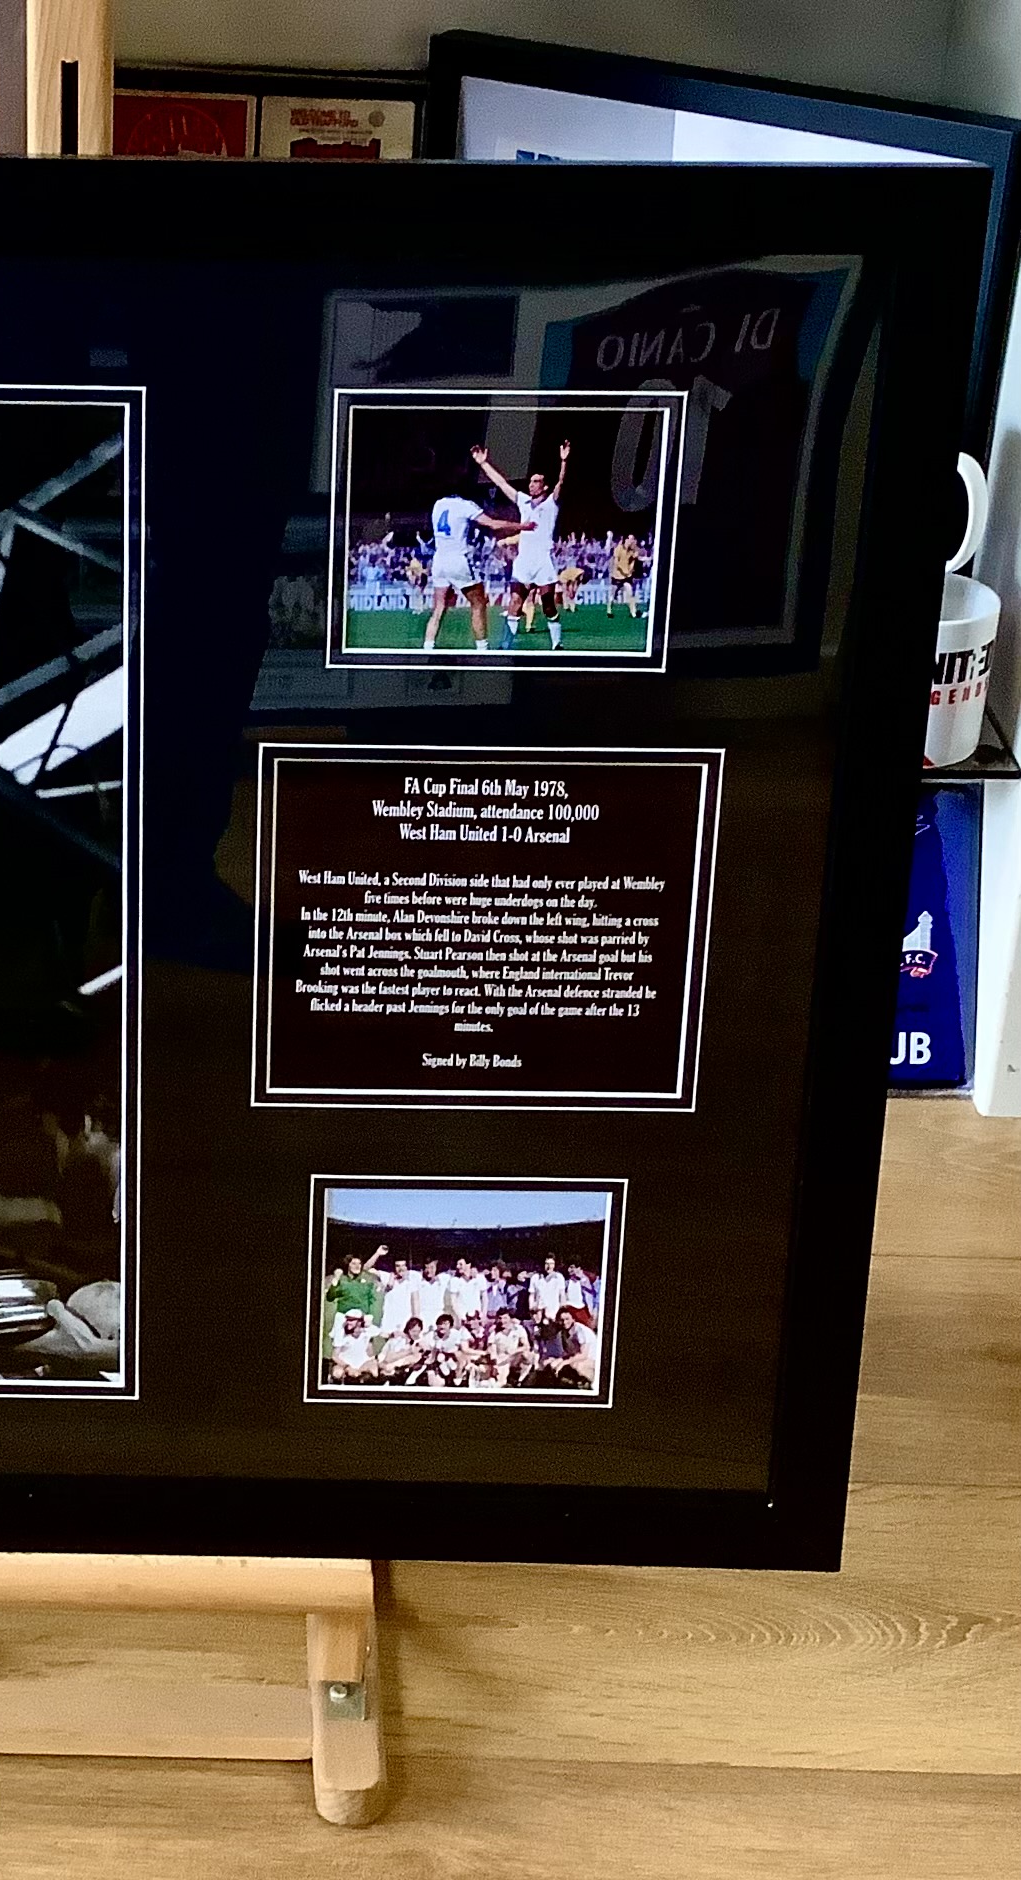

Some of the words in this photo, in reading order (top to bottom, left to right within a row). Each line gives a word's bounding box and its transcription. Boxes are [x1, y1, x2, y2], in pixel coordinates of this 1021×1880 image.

[436, 509, 452, 537] 4
[404, 776, 421, 795] FA
[423, 777, 447, 798] Cup
[449, 777, 479, 796] Final
[481, 778, 502, 796] 6th
[504, 778, 530, 799] May
[533, 780, 569, 800] 1978,
[371, 799, 425, 820] Wembley
[426, 800, 478, 820] Stadium,
[479, 802, 544, 820] attendance
[548, 803, 600, 823] 100,000
[399, 822, 427, 840] West
[429, 823, 457, 841] Ham
[459, 823, 498, 842] United
[501, 825, 523, 843] 1-0
[524, 826, 571, 844] Arsenal
[298, 869, 322, 884] West
[323, 870, 346, 885] Ham
[383, 876, 390, 886] a
[391, 871, 427, 887] Second
[428, 872, 468, 888] Division
[469, 873, 490, 888] side
[491, 873, 511, 889] that
[511, 874, 531, 889] had
[531, 874, 553, 892] only
[554, 880, 576, 890] ever
[577, 875, 610, 893] played
[610, 878, 621, 890] at
[623, 875, 666, 893] Wembley
[364, 890, 382, 904] five
[383, 891, 410, 905] times
[411, 890, 443, 906] before
[444, 896, 468, 906] were
[469, 892, 493, 909] huge
[493, 892, 544, 910] underdogs
[545, 898, 559, 908] on
[559, 894, 576, 908] the
[300, 906, 312, 921] In
[312, 907, 329, 921] the
[331, 907, 354, 922] 12th
[392, 908, 415, 924] Alan
[416, 909, 470, 925] Devonshire
[471, 910, 500, 925] broke
[500, 911, 528, 926] down
[528, 911, 545, 926] the
[546, 911, 563, 926] left
[591, 913, 623, 929] hitting
[624, 917, 632, 927] a
[632, 917, 659, 927] cross
[308, 925, 327, 939] into
[328, 925, 345, 940] the
[345, 926, 384, 941] Arsenal
[384, 926, 403, 941] box
[404, 927, 433, 942] which
[434, 928, 450, 942] fell
[451, 930, 462, 943] to
[463, 928, 492, 943] David
[525, 930, 556, 944] whose
[556, 930, 579, 945] shot
[580, 935, 600, 945] was
[600, 930, 637, 947] parried
[637, 931, 650, 948] by
[349, 944, 366, 959] Pat
[413, 945, 443, 961] Stuart
[444, 946, 484, 961] Pearson
[485, 947, 507, 962] then
[508, 948, 529, 962] shot
[530, 950, 541, 962] at
[542, 948, 559, 962] the
[559, 948, 597, 963] Arsenal
[598, 949, 619, 965] goal
[620, 949, 637, 963] but
[637, 949, 653, 964] his
[319, 962, 341, 976] shot
[342, 964, 366, 977] went
[367, 967, 399, 977] across
[399, 963, 416, 978] the
[471, 965, 501, 980] where
[502, 965, 541, 982] England
[541, 966, 602, 981] international
[603, 967, 635, 981] Trevor
[295, 978, 339, 997] Brooking
[340, 985, 360, 994] was
[361, 981, 377, 995] the
[378, 981, 410, 996] fastest
[411, 982, 441, 998] player
[442, 985, 453, 996] to
[483, 983, 506, 997] With
[507, 984, 524, 998] the
[524, 984, 563, 998] Arsenal
[563, 984, 600, 999] defence
[601, 984, 644, 1000] stranded
[644, 985, 657, 1000] he
[310, 997, 343, 1012] flicked
[343, 1003, 350, 1012] a
[351, 998, 385, 1013] header
[385, 1001, 406, 1016] past
[407, 999, 450, 1016] Jennings
[451, 1000, 466, 1014] for
[467, 1001, 484, 1015] the
[484, 1001, 506, 1018] only
[506, 1001, 528, 1018] goal
[528, 1001, 541, 1016] of
[539, 1002, 556, 1016] the
[557, 1006, 584, 1018] game
[584, 1002, 608, 1017] after
[608, 1002, 625, 1017] the
[627, 1003, 640, 1017] 13
[421, 1052, 454, 1069] Signed
[455, 1053, 468, 1069] by
[469, 1053, 491, 1070] Billy
[492, 1054, 523, 1068] Bonds
